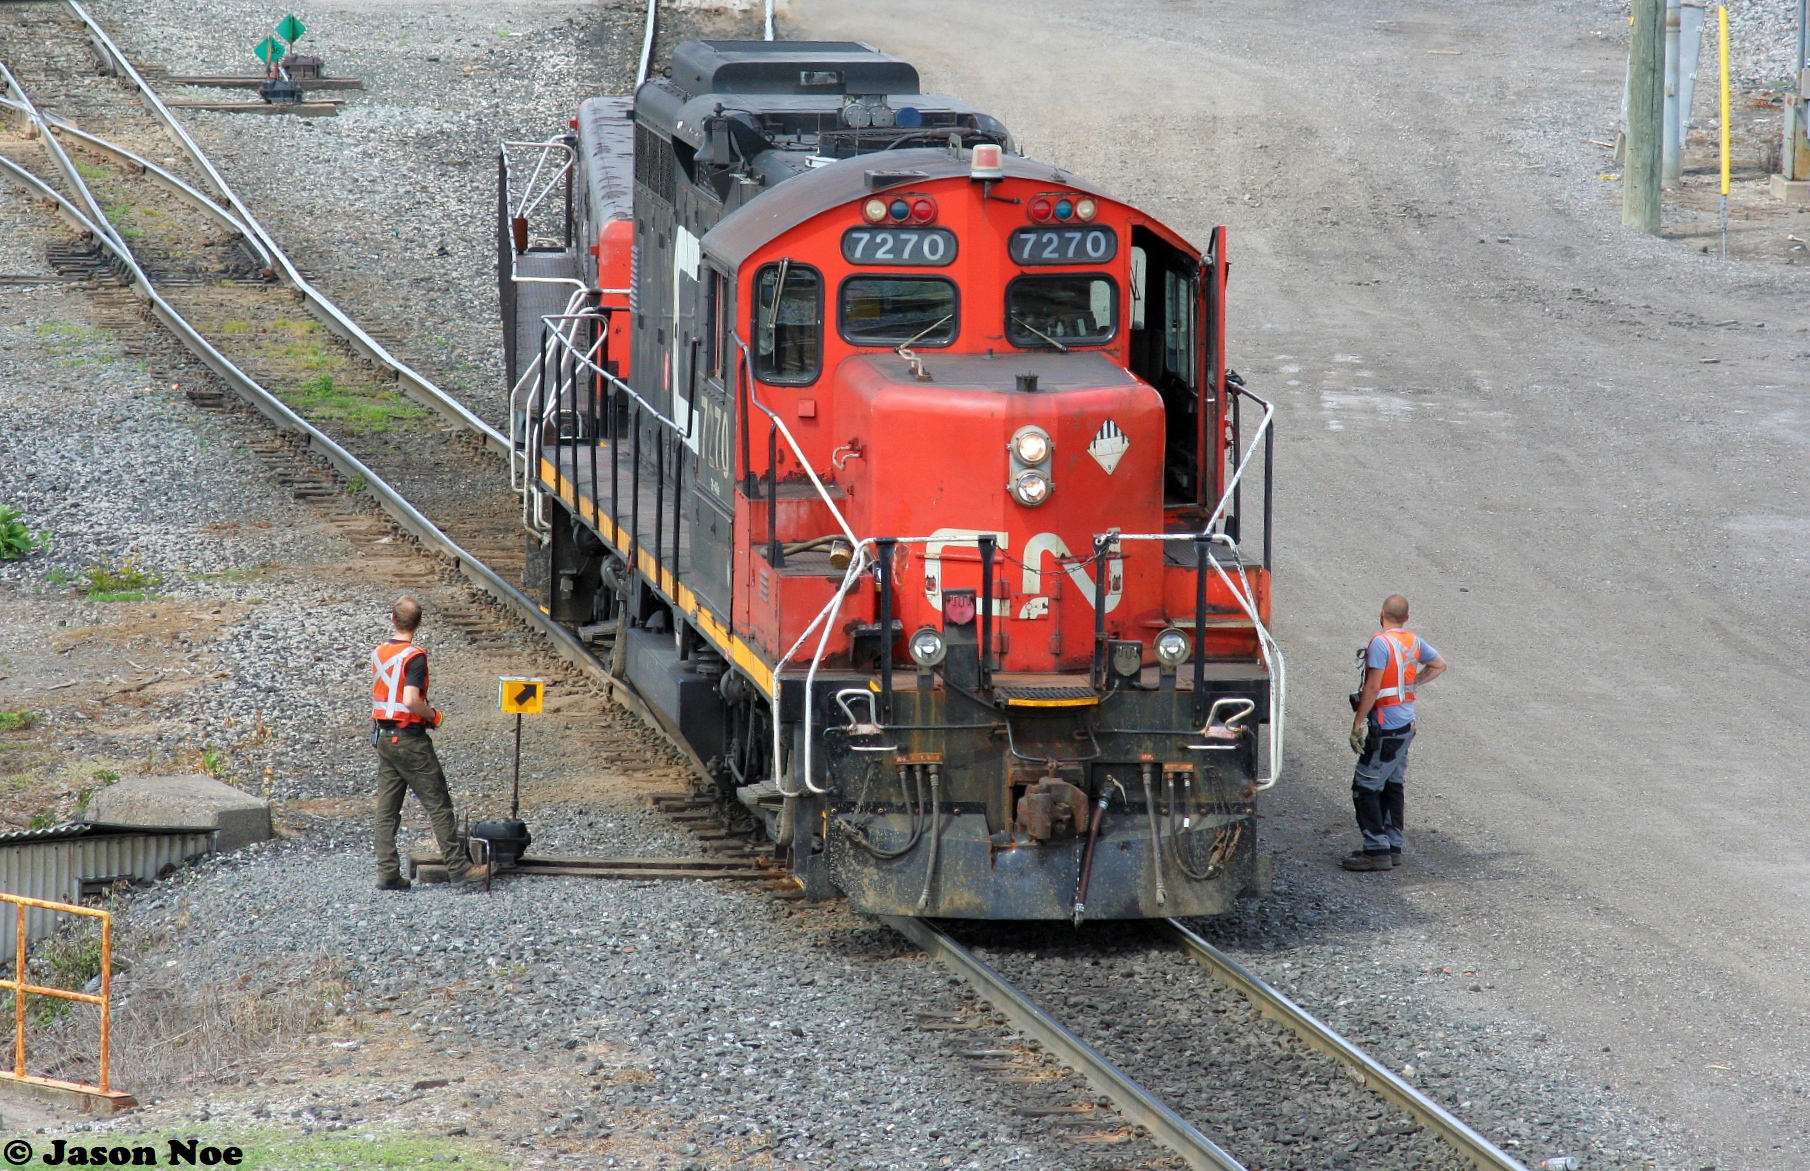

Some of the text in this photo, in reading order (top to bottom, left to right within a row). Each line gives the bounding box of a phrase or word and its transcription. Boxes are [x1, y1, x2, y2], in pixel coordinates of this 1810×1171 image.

[851, 232, 945, 261] 7270
[1019, 231, 1107, 259] 7270
[701, 395, 730, 479] 7270
[924, 527, 1124, 620] CN
